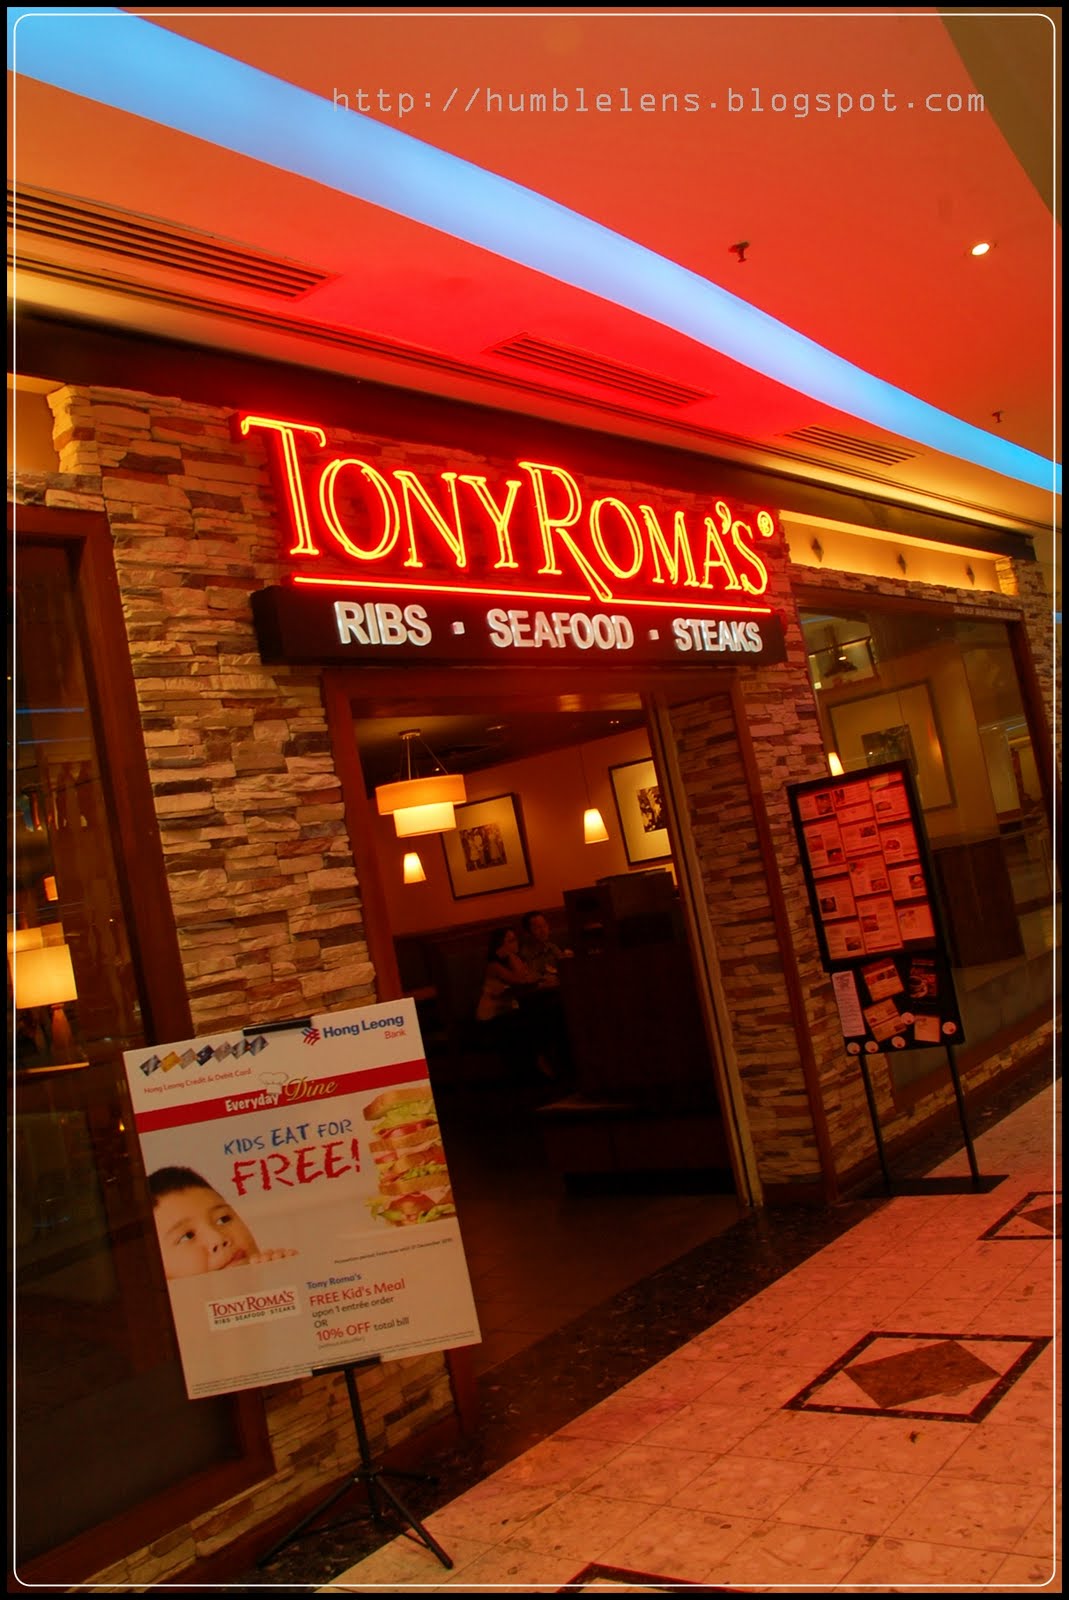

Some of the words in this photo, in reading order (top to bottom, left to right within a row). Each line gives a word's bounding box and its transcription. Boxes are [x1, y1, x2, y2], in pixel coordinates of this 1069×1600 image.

[334, 600, 432, 646] RIBS
[487, 608, 634, 650] SEAFOOD
[674, 618, 763, 653] STEAKS
[322, 1024, 360, 1038] Hong
[361, 1015, 404, 1031] Leong
[384, 1029, 406, 1040] Bank
[143, 1085, 163, 1094] Hong
[234, 1068, 252, 1077] Card
[225, 1093, 280, 1113] Everyday
[284, 1076, 338, 1101] Dine
[223, 1135, 265, 1156] KIDS
[271, 1123, 310, 1147] EAT
[317, 1119, 353, 1138] FOR
[232, 1138, 361, 1197] FREE!
[305, 1281, 327, 1290] Tony
[328, 1273, 362, 1286] Roma's
[308, 1291, 340, 1307] FREE
[341, 1286, 372, 1301] Kid's
[373, 1277, 406, 1295] Meal
[213, 1317, 232, 1325] RIBS
[234, 1310, 266, 1321] SEAFOOD
[269, 1304, 297, 1315] STEAKS
[311, 1308, 334, 1318] upon
[335, 1305, 341, 1313] 1
[370, 1295, 395, 1307] order
[313, 1319, 329, 1329] OR
[316, 1327, 344, 1342] 10%
[345, 1321, 372, 1337] OFF
[373, 1319, 396, 1331] total
[396, 1316, 410, 1327] bill
